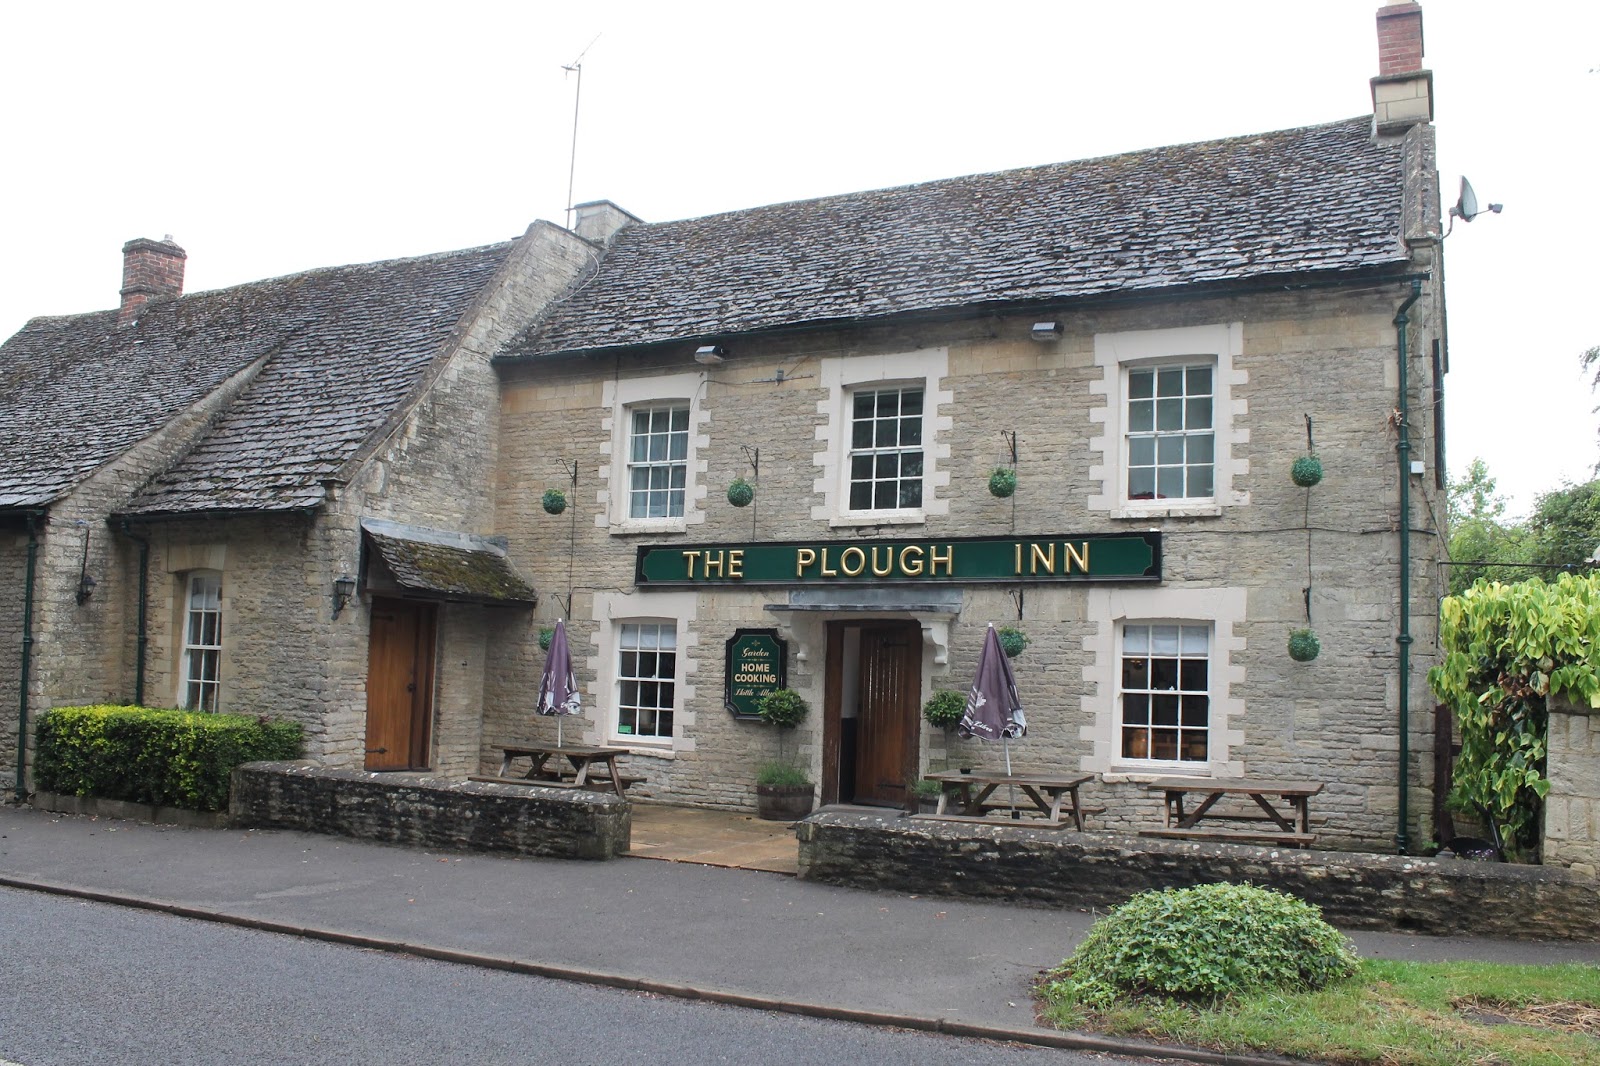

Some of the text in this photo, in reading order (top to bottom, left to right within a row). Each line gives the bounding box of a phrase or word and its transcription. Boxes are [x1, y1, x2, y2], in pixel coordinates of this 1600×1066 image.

[682, 541, 1090, 579] THE PLOUGH INN
[742, 648, 770, 658] Garden
[741, 663, 770, 672] HOME
[734, 674, 776, 682] COOKING
